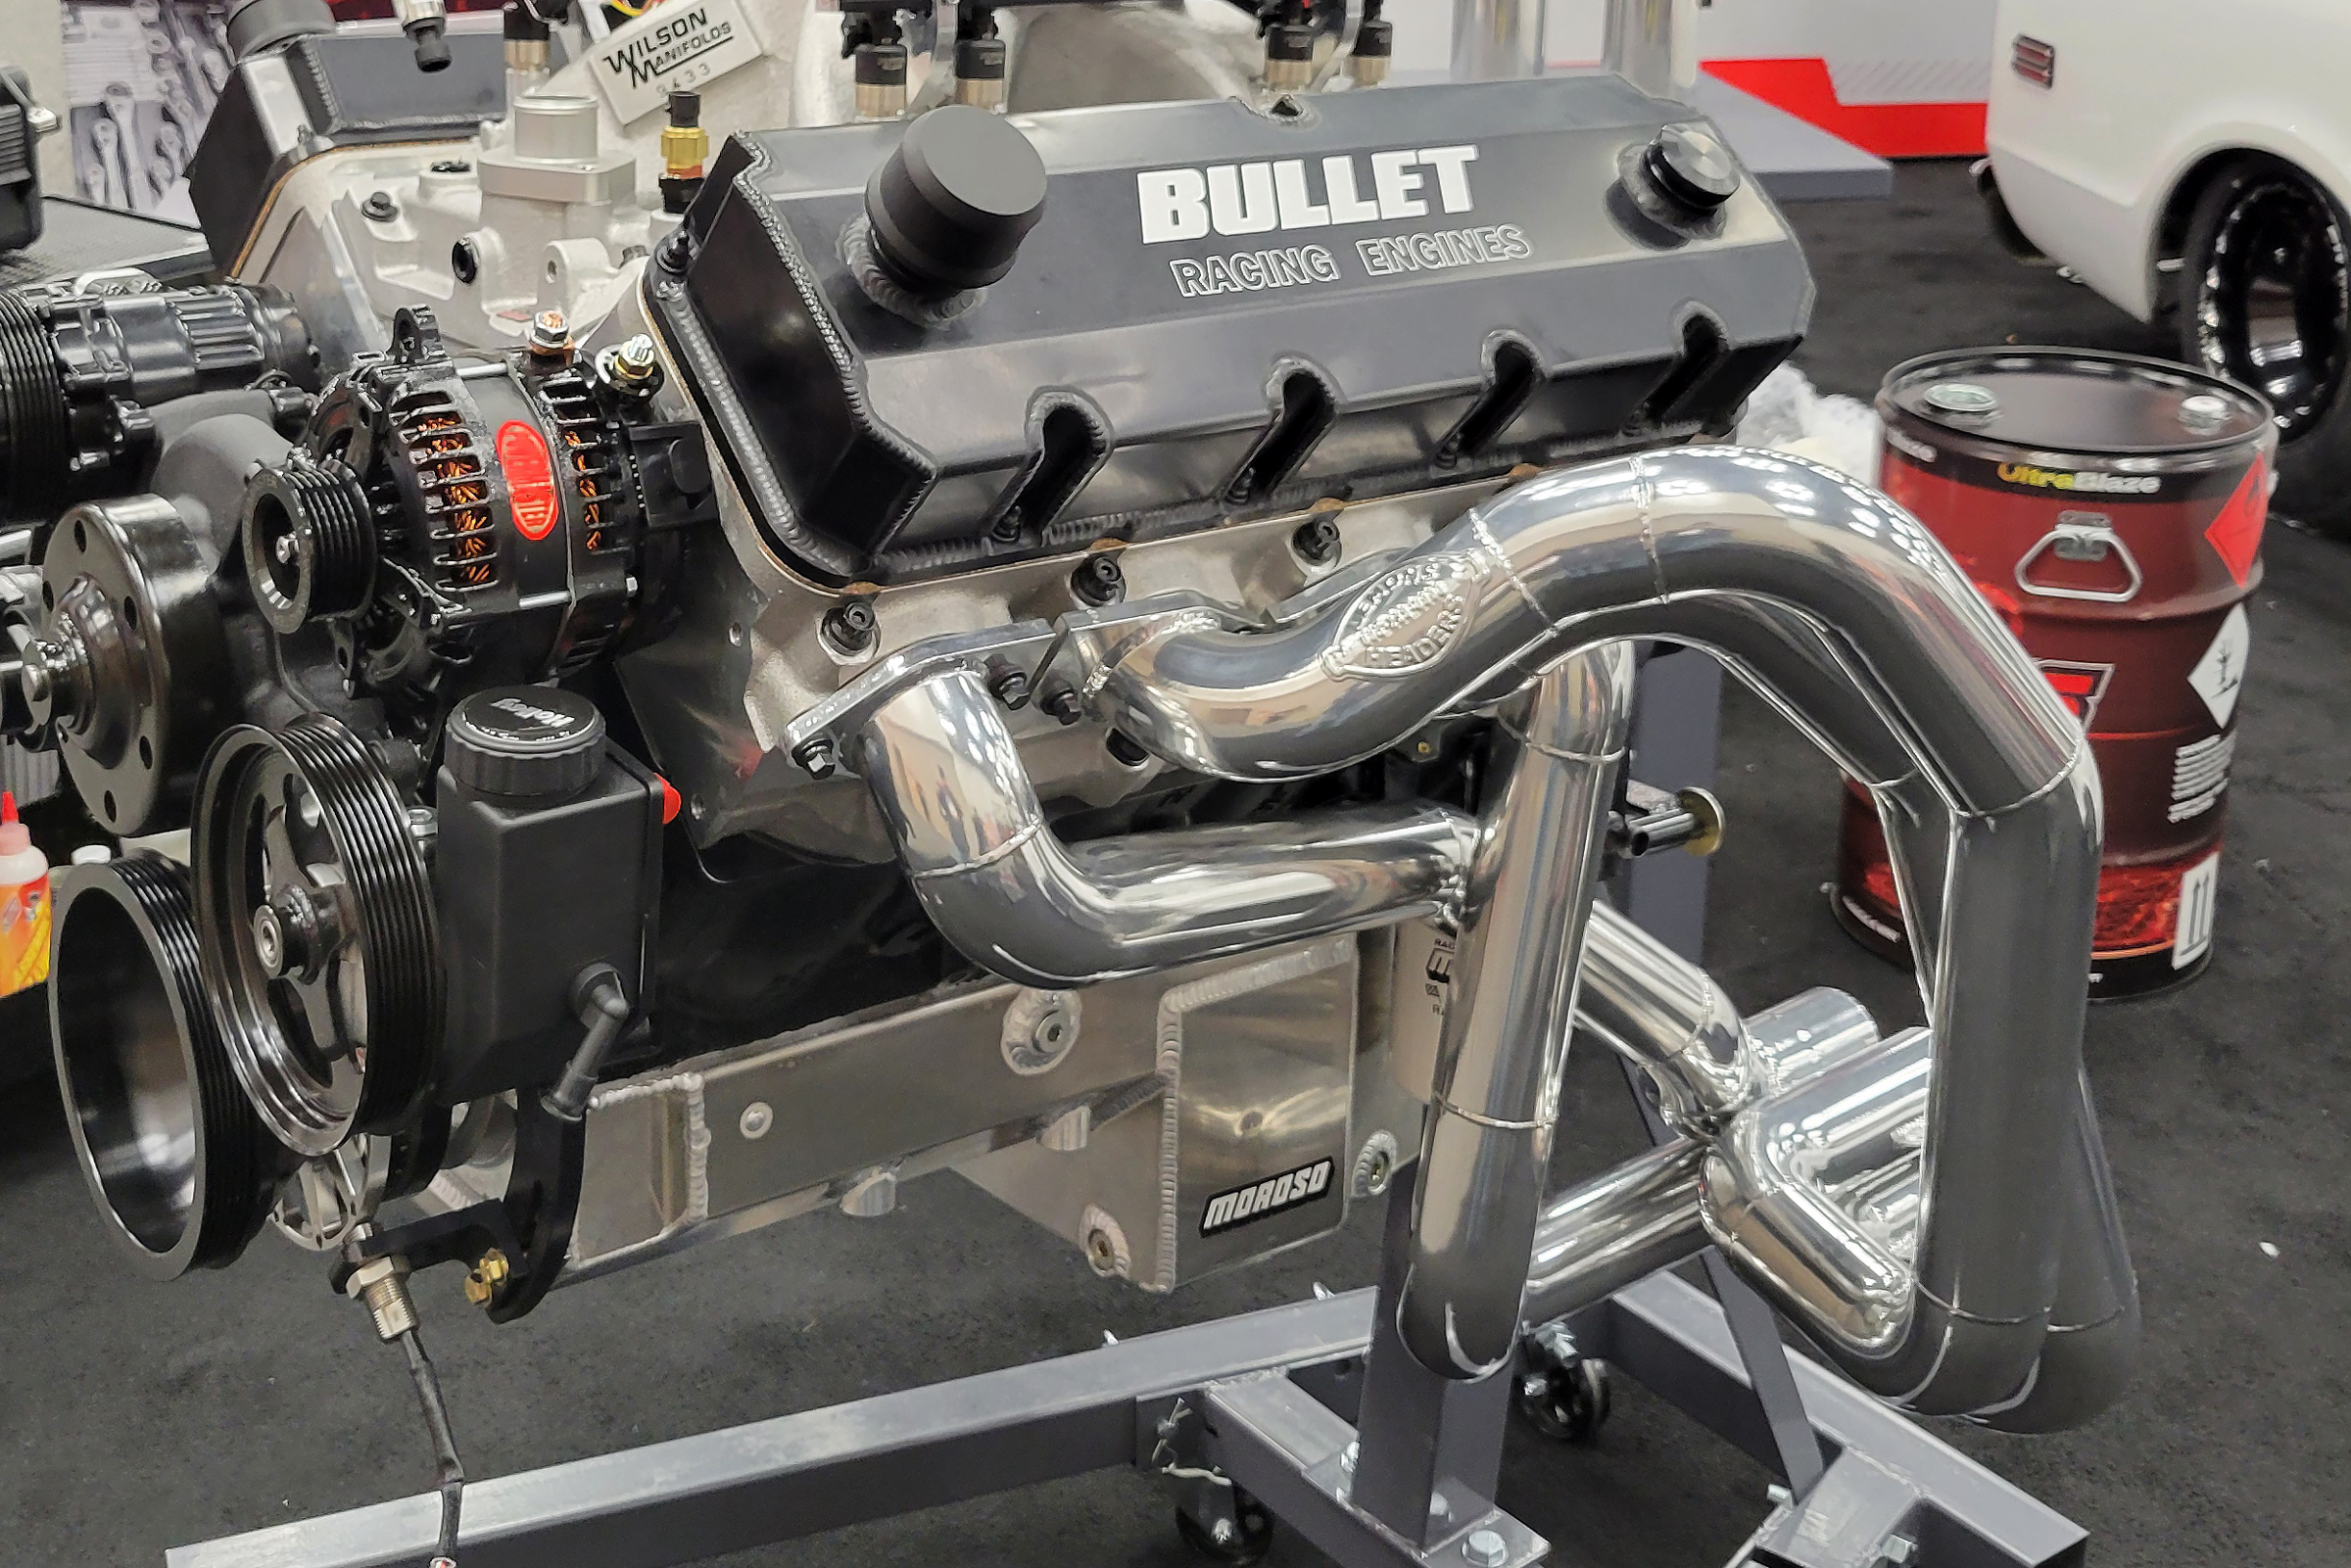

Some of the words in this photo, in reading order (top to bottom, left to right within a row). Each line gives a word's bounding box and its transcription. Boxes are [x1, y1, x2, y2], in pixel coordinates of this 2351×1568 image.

[602, 8, 708, 75] WILSON
[632, 22, 732, 89] MANIFOLDS
[1136, 145, 1479, 244] BULLET
[1169, 244, 1341, 298] RACING
[1356, 223, 1535, 277] ENGINES
[491, 697, 576, 728] Holley
[1203, 1161, 1332, 1230] MOROSO
